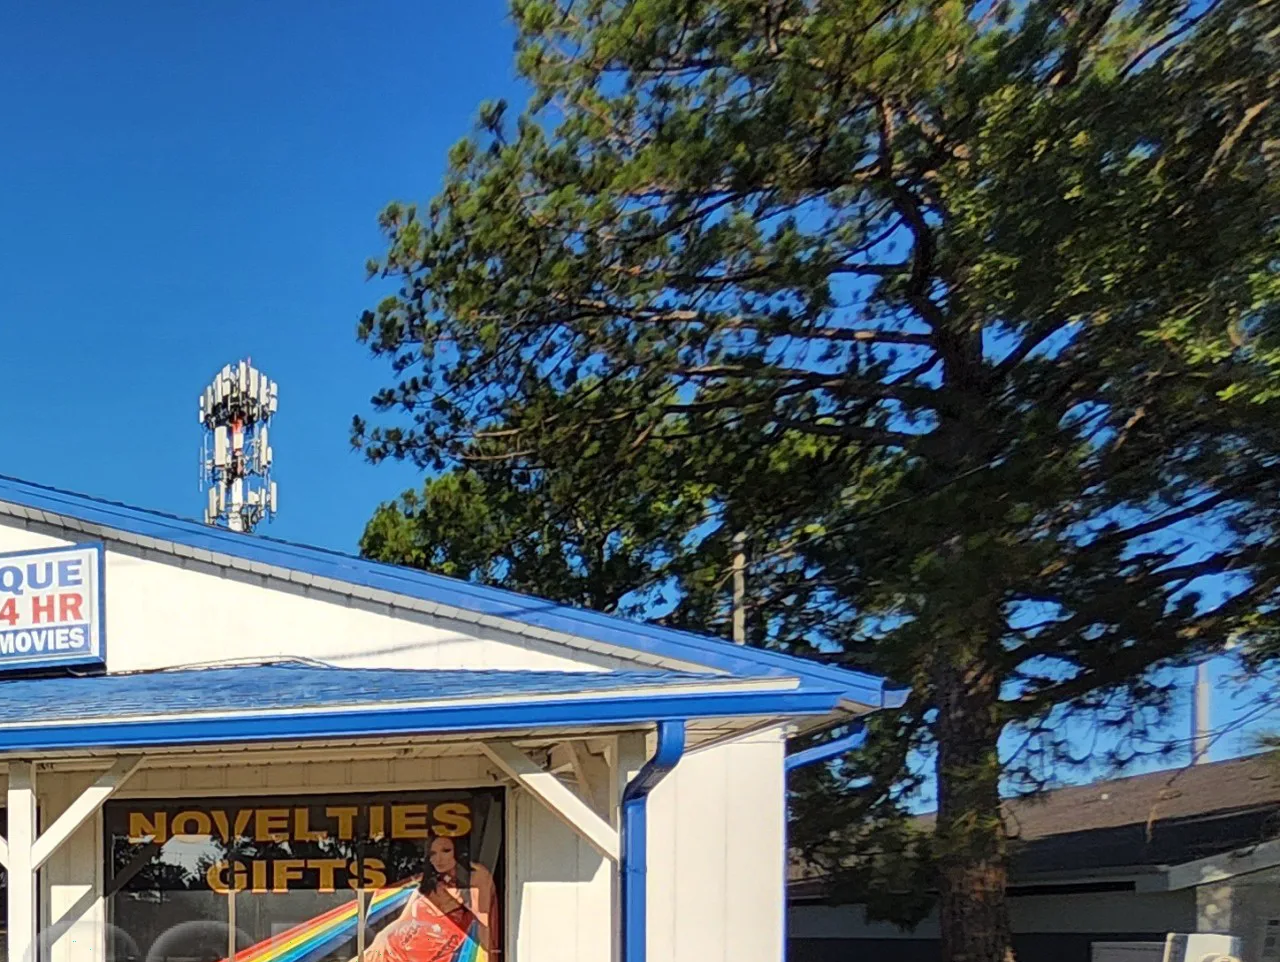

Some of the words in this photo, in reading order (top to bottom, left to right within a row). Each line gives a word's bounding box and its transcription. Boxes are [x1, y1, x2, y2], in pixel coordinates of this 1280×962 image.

[32, 593, 83, 625] HR
[129, 802, 472, 843] NOVELTIES
[206, 859, 387, 894] GIFTS
